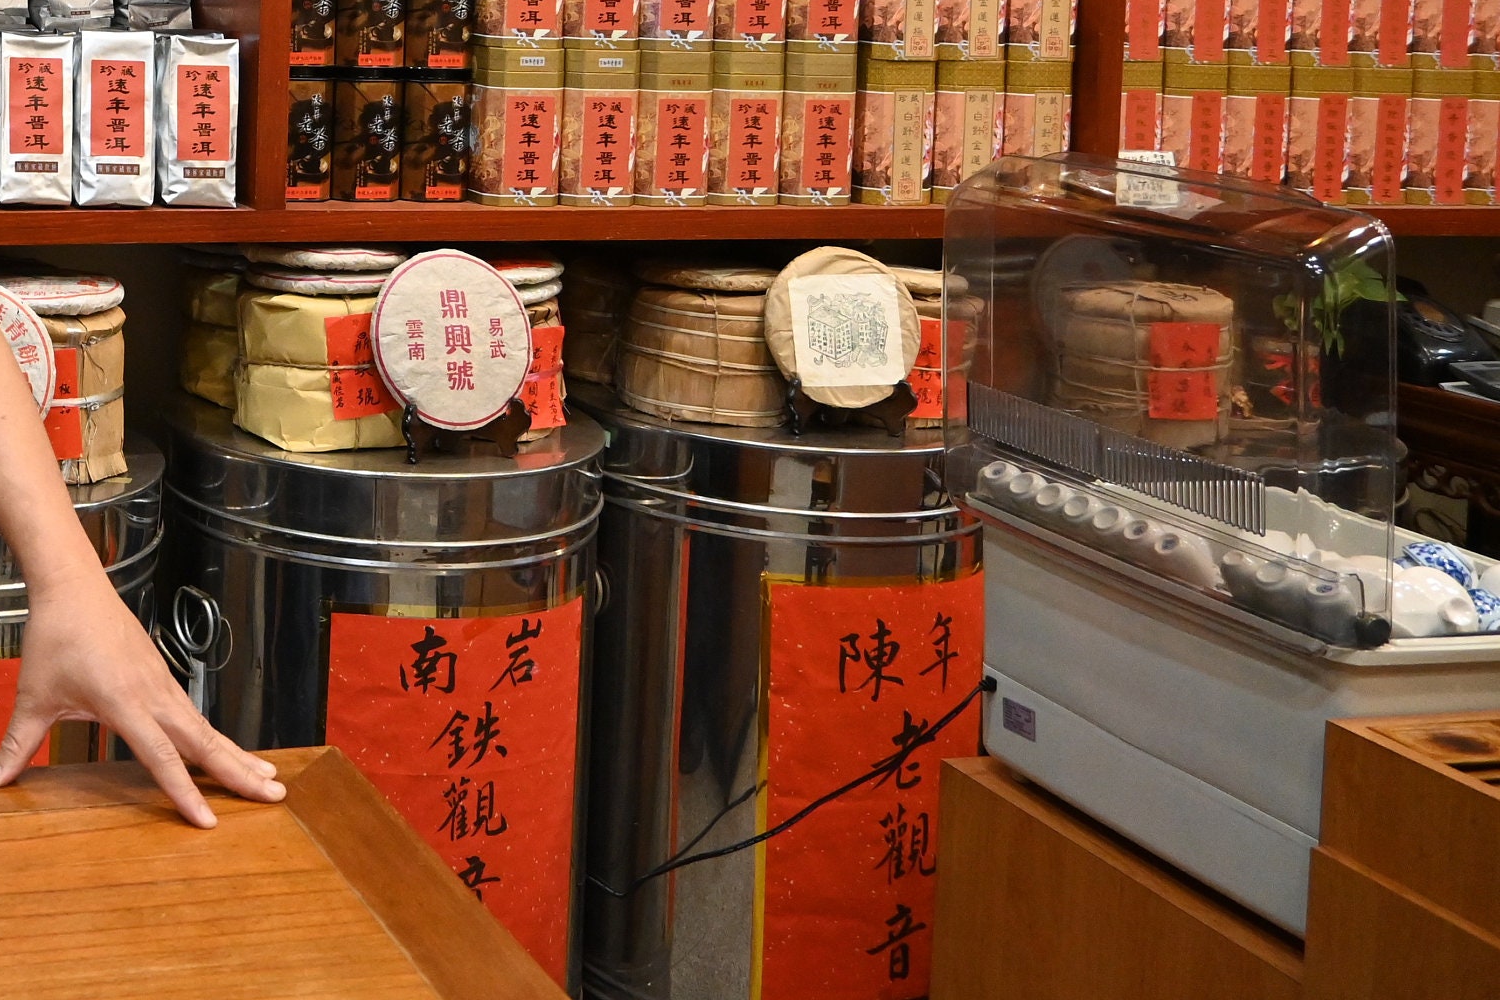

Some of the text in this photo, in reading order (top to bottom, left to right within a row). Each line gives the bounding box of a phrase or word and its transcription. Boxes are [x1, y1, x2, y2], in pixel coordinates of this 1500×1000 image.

[18, 61, 54, 76] 珍藏
[99, 63, 137, 78] 珍藏
[185, 69, 221, 83] 珍藏
[405, 319, 426, 361] 雲南
[439, 289, 476, 392] 鼎興號
[488, 317, 507, 360] 易武
